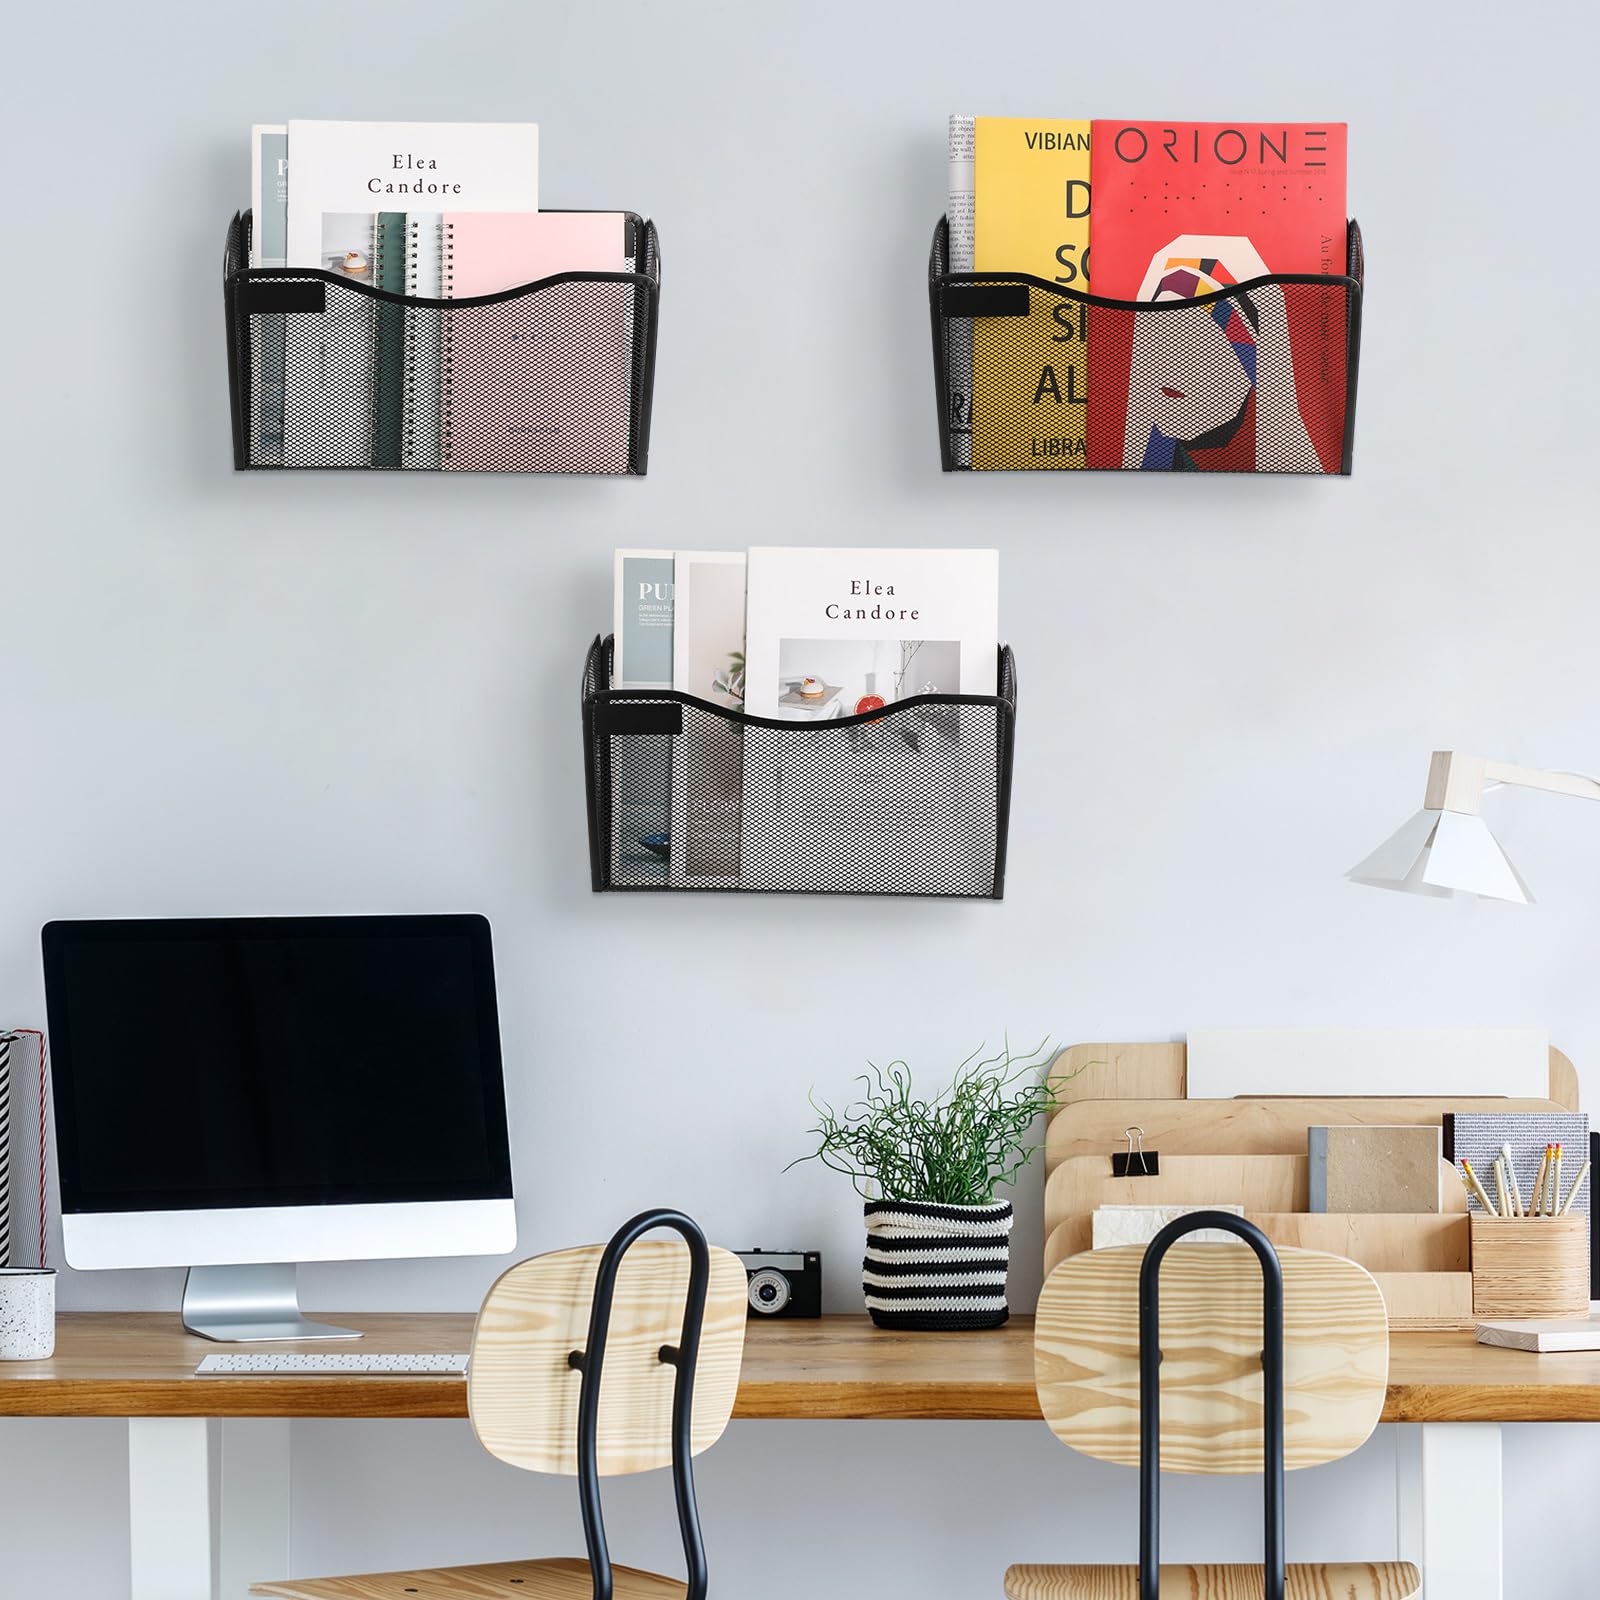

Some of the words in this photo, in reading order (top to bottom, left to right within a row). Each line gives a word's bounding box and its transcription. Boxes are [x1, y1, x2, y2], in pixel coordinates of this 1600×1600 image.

[1025, 131, 1091, 151] VIBIAN
[1114, 127, 1328, 167] ORIONE
[392, 153, 437, 170] Elea
[367, 177, 461, 194] Candore
[1033, 364, 1089, 404] AL
[850, 579, 895, 596] Elea
[825, 603, 920, 620] Candore
